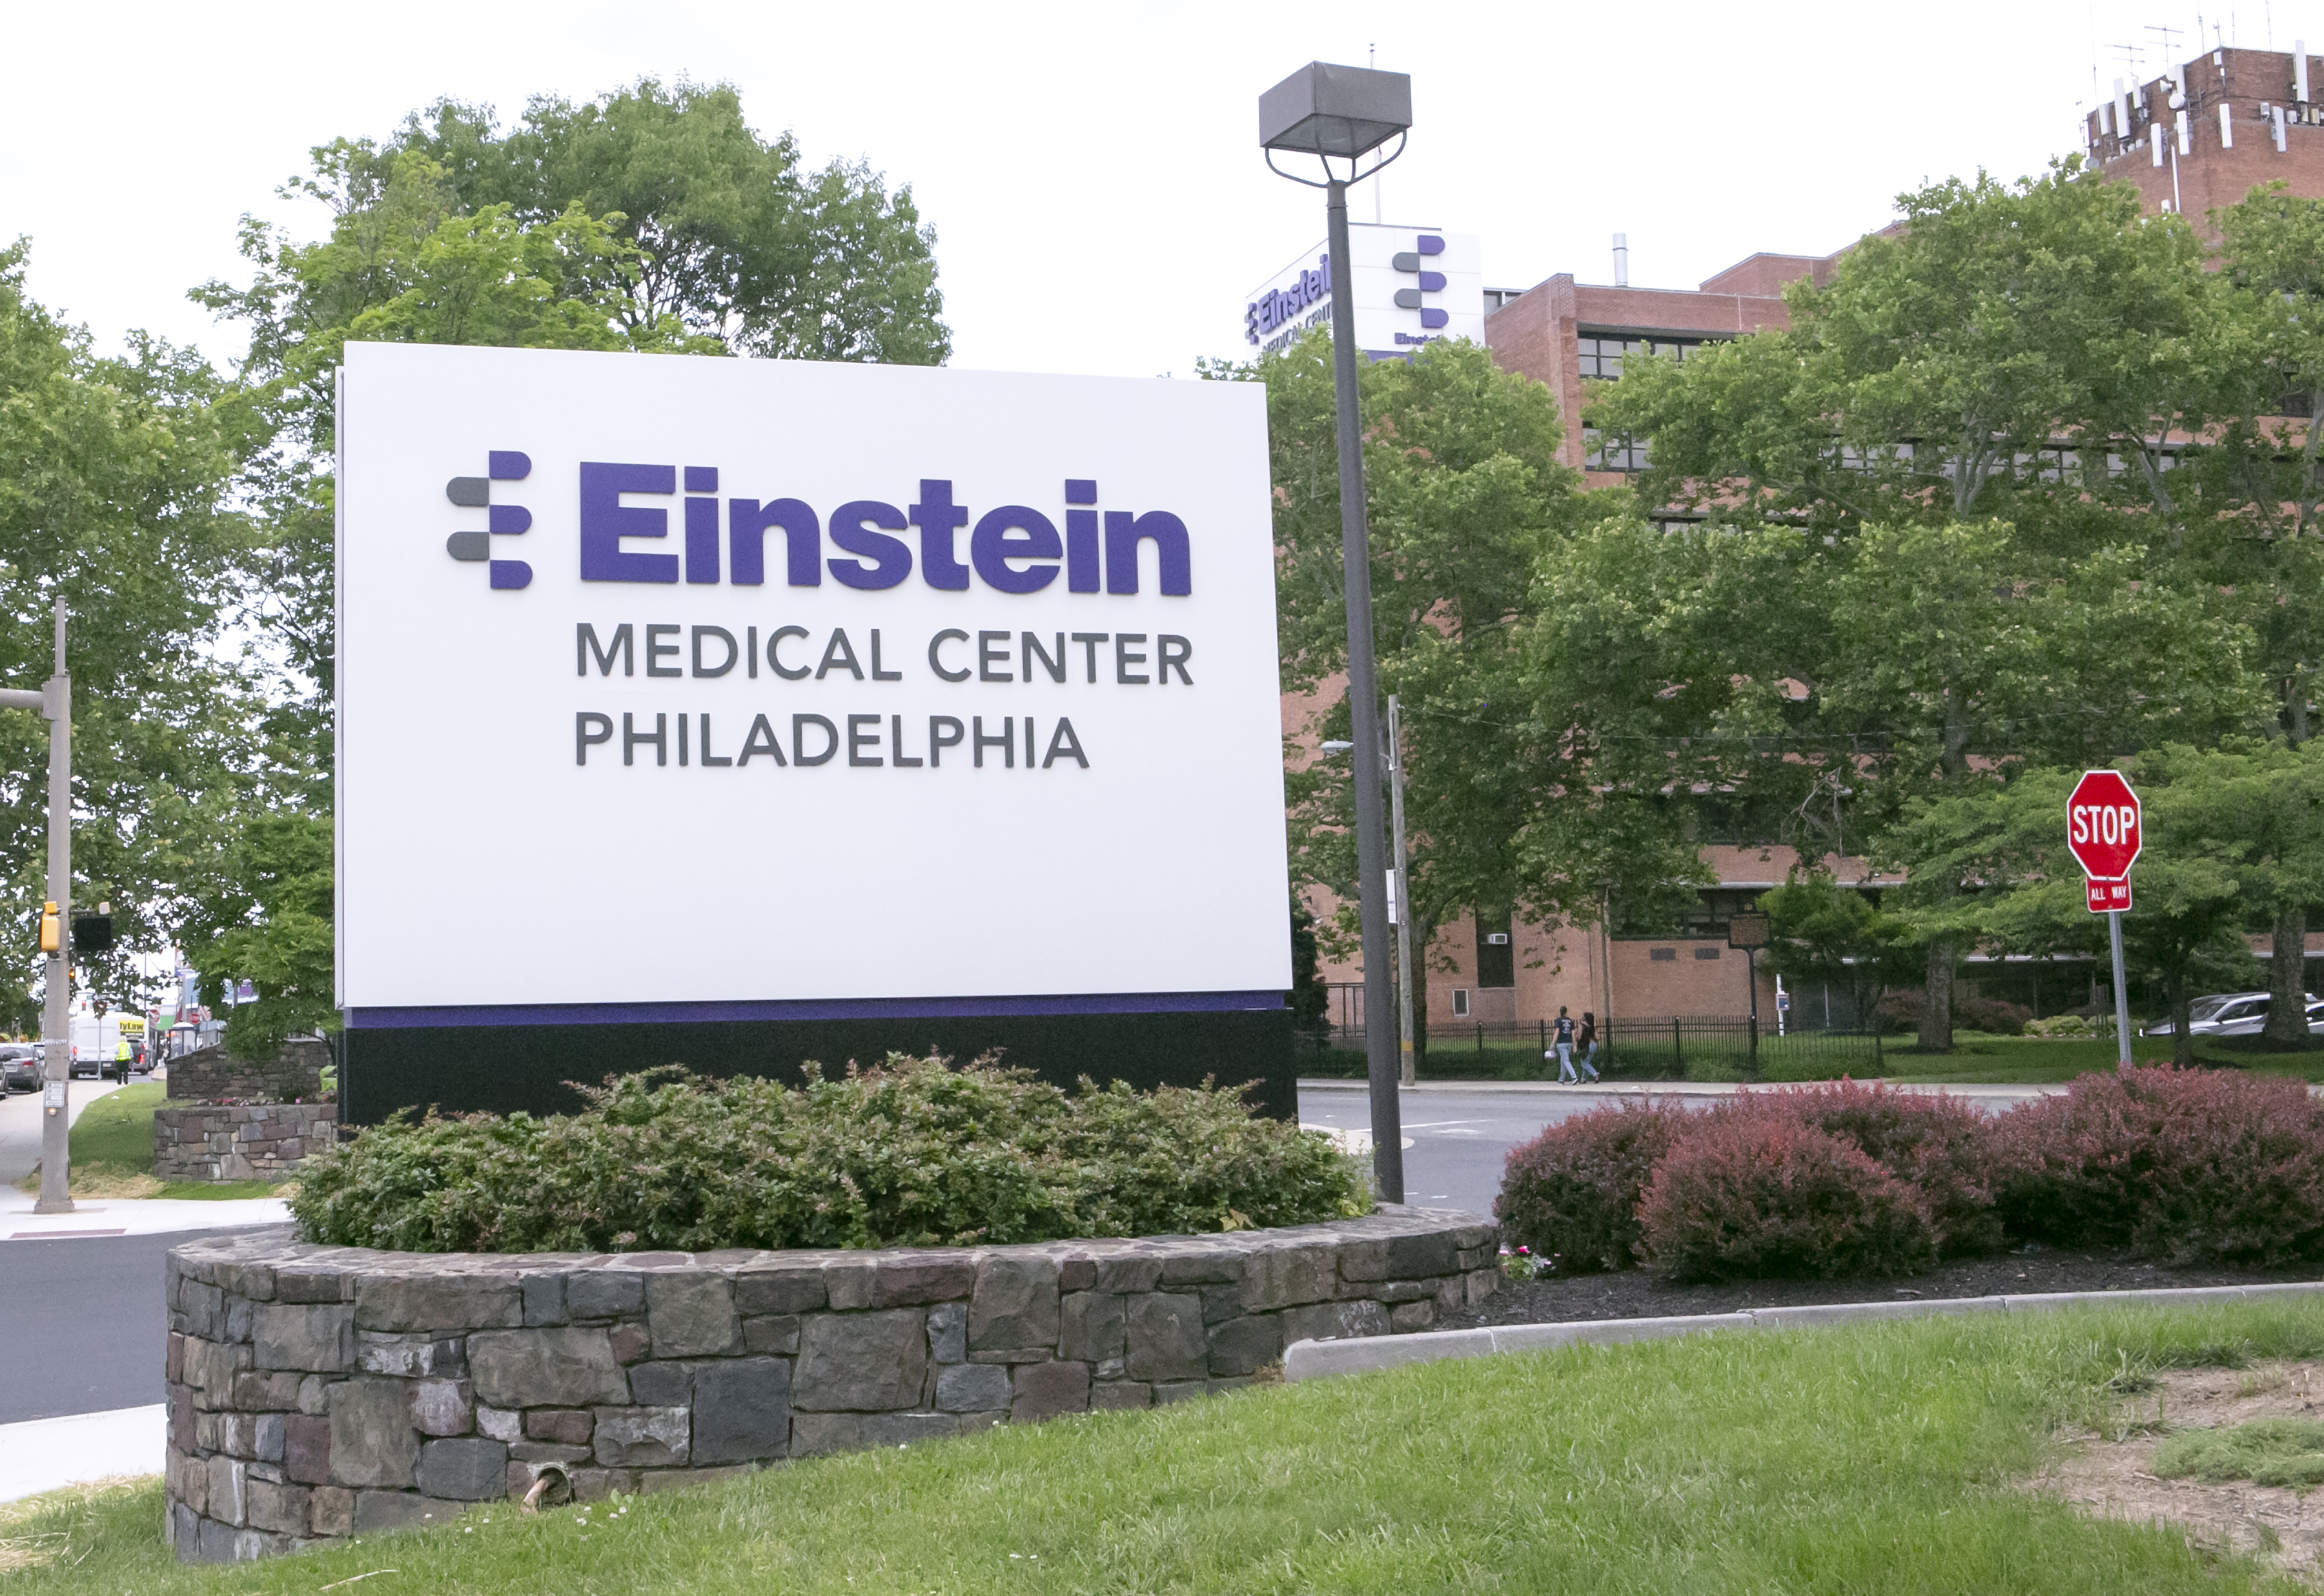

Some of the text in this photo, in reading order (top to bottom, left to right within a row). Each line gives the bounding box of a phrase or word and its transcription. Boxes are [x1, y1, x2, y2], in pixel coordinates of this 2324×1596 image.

[1262, 322, 1301, 353] MEDICA
[580, 462, 1192, 597] Einstein
[576, 622, 1194, 686] MEDICAL CENTER
[576, 711, 1090, 769] PHILADELPHIA
[2073, 804, 2135, 845] STOP
[2091, 886, 2126, 901] ALL WAY
